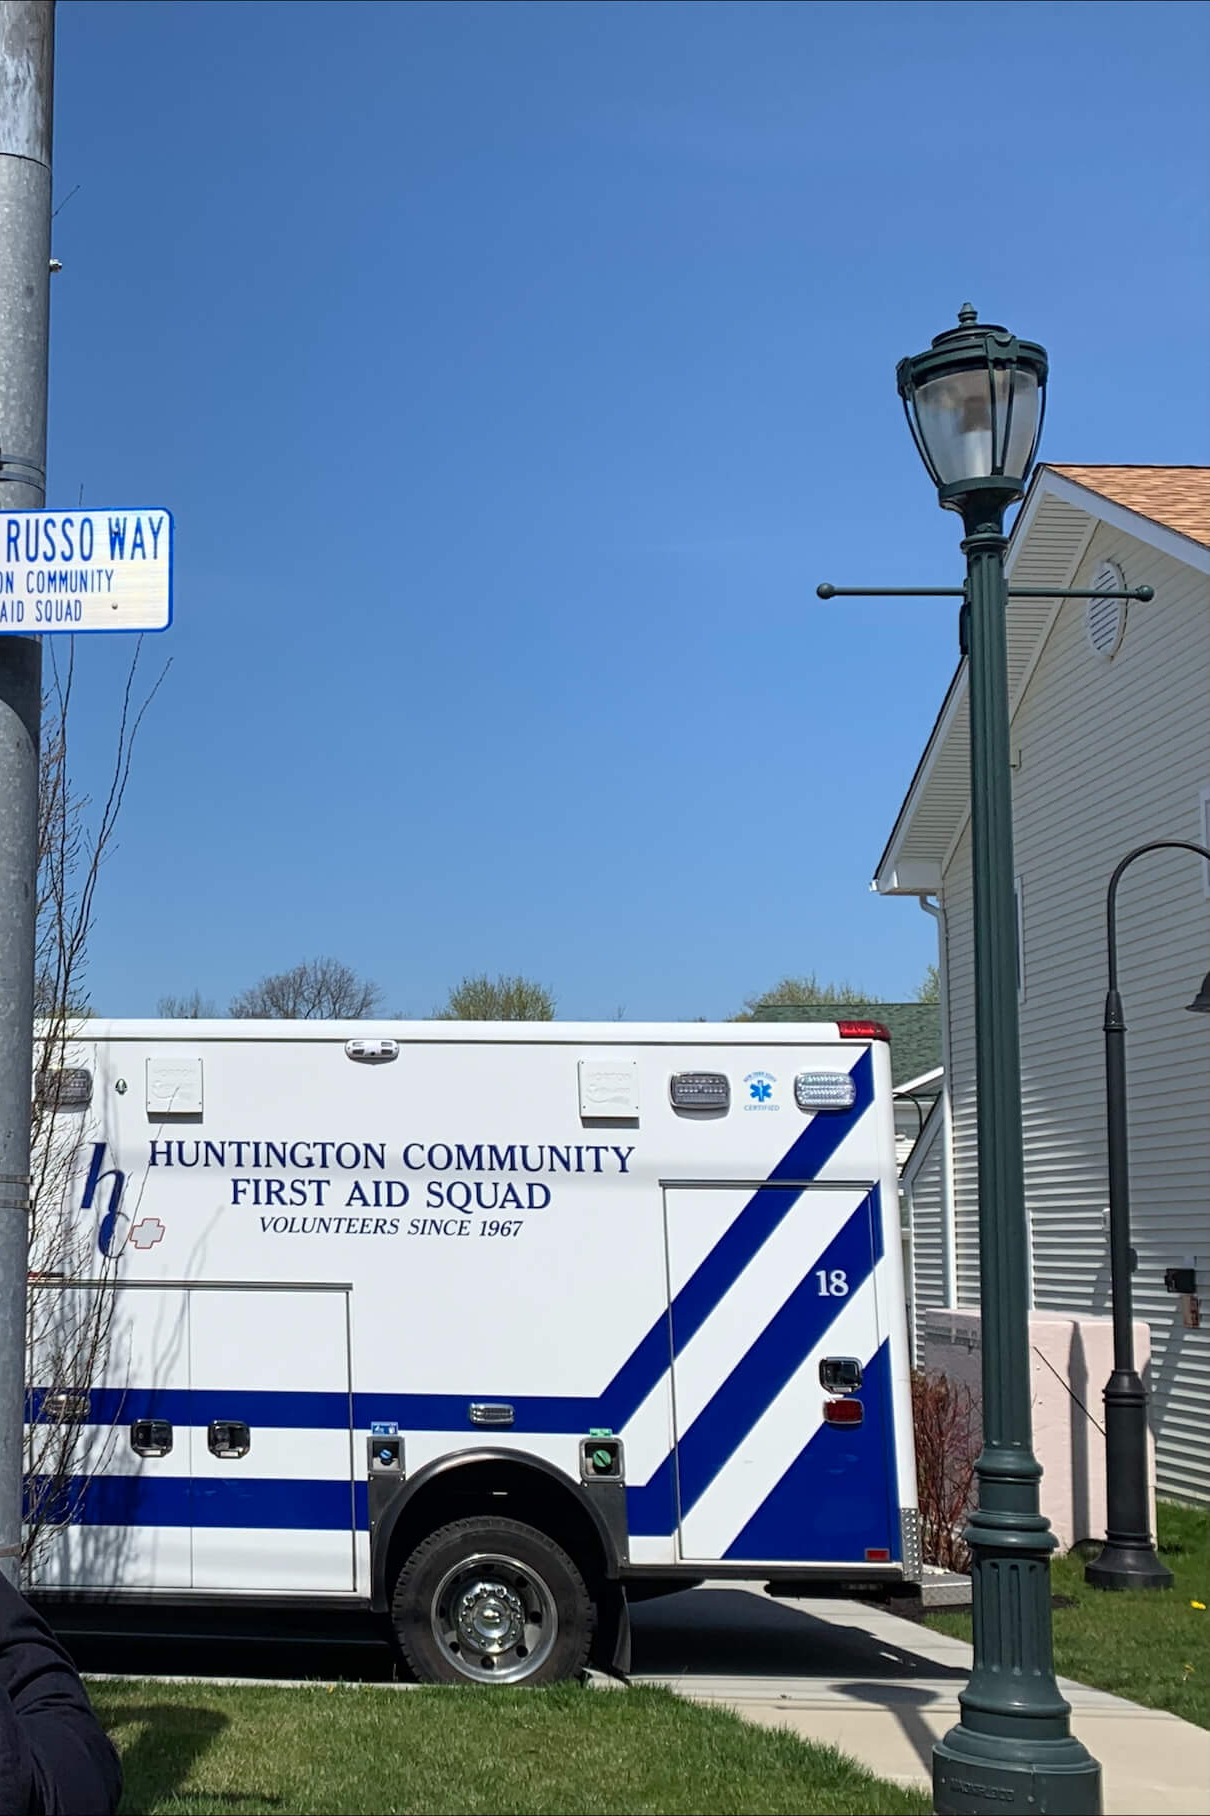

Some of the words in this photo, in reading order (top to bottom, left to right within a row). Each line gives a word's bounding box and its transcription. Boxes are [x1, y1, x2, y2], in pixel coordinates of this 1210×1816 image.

[6, 517, 94, 562] RUSSO
[107, 516, 164, 561] WAY
[26, 569, 115, 594] COMMUNITY
[0, 600, 24, 623] AID
[35, 599, 83, 623] SQUAD
[148, 1140, 387, 1170] HUNTINGTON
[402, 1143, 636, 1173] COMMUNITY
[230, 1178, 331, 1207] FIRST
[344, 1180, 410, 1208] AID
[426, 1181, 552, 1214] SQUAD
[259, 1216, 400, 1235] VOLUNTEERS
[407, 1218, 471, 1236] SINCE
[479, 1220, 524, 1237] 1967
[815, 1269, 849, 1297] 18
